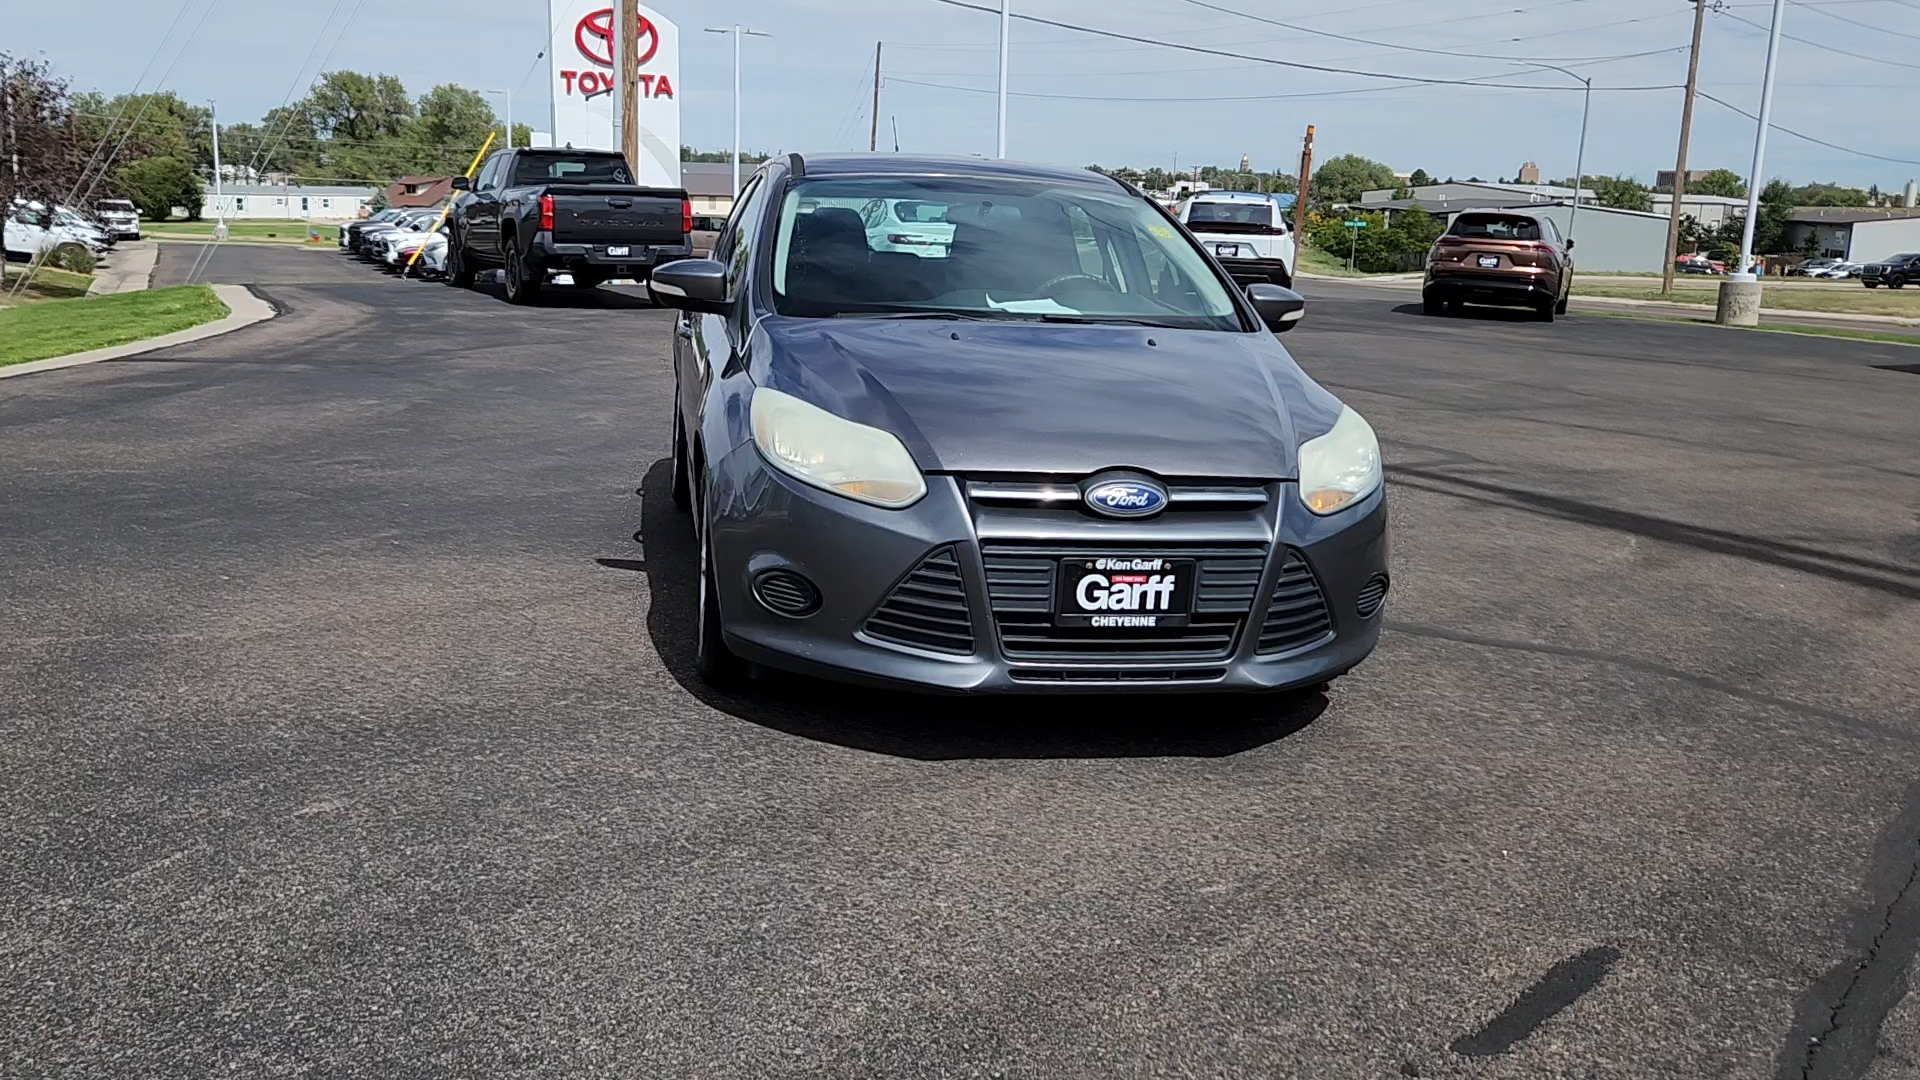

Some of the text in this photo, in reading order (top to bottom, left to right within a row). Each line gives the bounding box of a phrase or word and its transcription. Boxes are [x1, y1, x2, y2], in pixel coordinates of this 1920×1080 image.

[560, 70, 673, 99] TOYTA
[1106, 488, 1149, 506] Ford
[1106, 559, 1163, 570] Ken Garff
[1076, 574, 1176, 611] Garff
[1091, 616, 1157, 627] CHEYENNE
